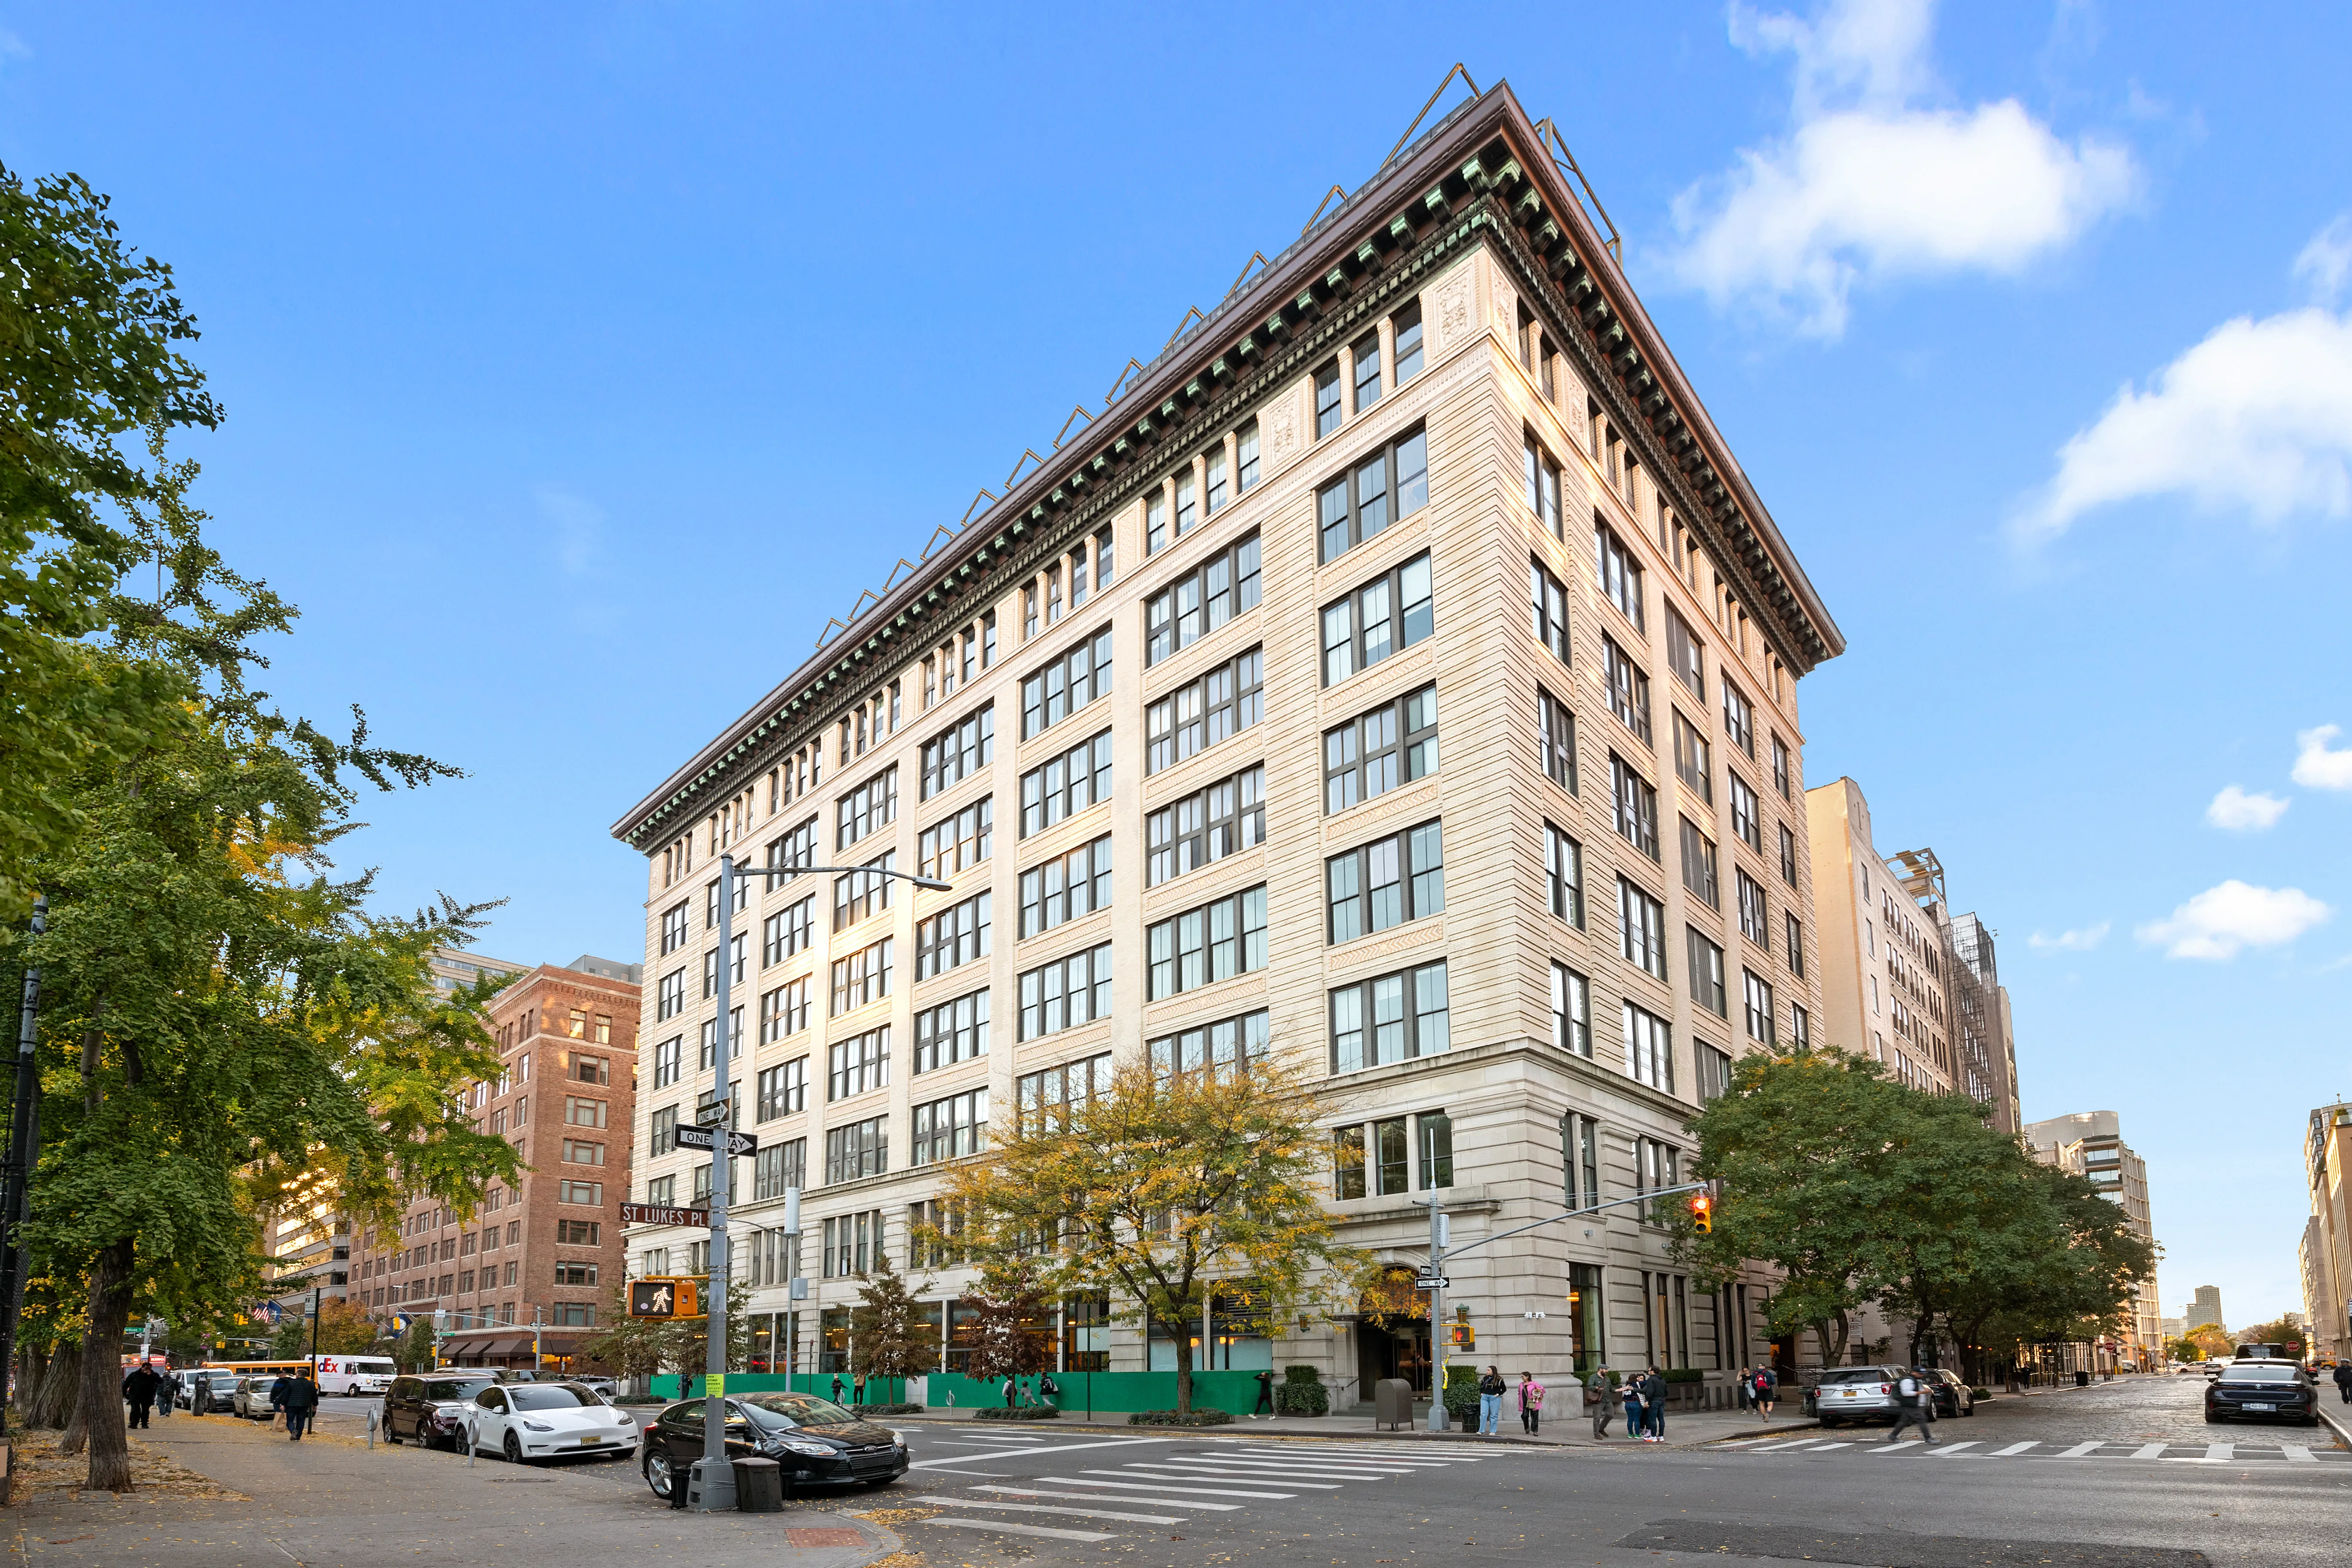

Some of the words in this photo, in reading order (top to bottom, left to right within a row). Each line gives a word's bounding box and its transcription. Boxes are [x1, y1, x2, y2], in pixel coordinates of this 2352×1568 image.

[700, 1111, 709, 1122] ONE
[713, 1106, 724, 1118] WAY
[687, 1133, 710, 1144] ONE
[728, 1138, 745, 1148] AY
[623, 1206, 638, 1220] ST
[645, 1208, 684, 1225] LUKES
[691, 1212, 706, 1226] PL
[318, 1358, 338, 1373] dEx
